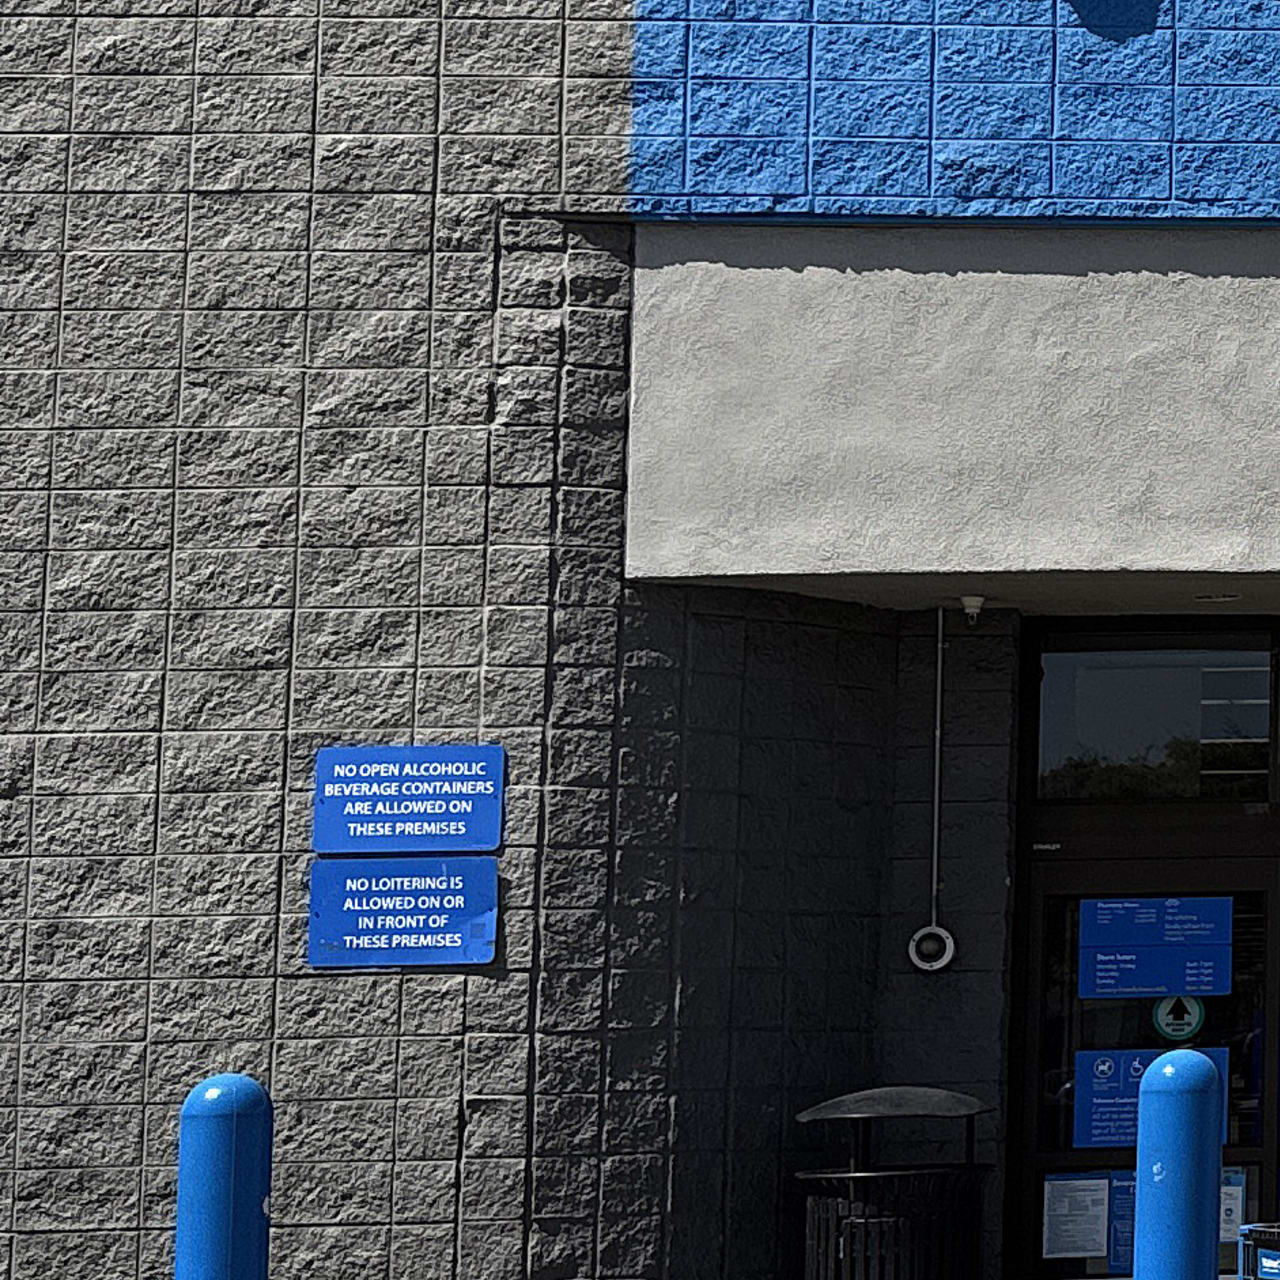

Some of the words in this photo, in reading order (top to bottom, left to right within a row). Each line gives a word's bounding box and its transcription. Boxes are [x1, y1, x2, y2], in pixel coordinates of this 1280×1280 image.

[334, 764, 357, 777] NO
[360, 763, 399, 777] OPEN
[402, 762, 486, 776] ALCOHOLIC
[324, 782, 399, 796] BEVERAGE
[401, 781, 494, 795] CONTAINERS
[343, 801, 372, 815] ARE
[375, 800, 446, 814] ALLOWED
[449, 800, 472, 813] ON
[348, 822, 392, 836] THESE
[395, 822, 466, 835] PREMISES
[345, 878, 369, 891] NO
[372, 877, 447, 891] LOITERING
[449, 876, 463, 889] IS
[343, 896, 415, 911] ALLOWED
[418, 896, 440, 909] ON
[443, 895, 464, 909] OR
[358, 915, 374, 930] IN
[377, 915, 427, 929] FRONT
[429, 915, 449, 928] OF
[344, 935, 389, 948] THESE
[392, 934, 462, 948] PREMISES
